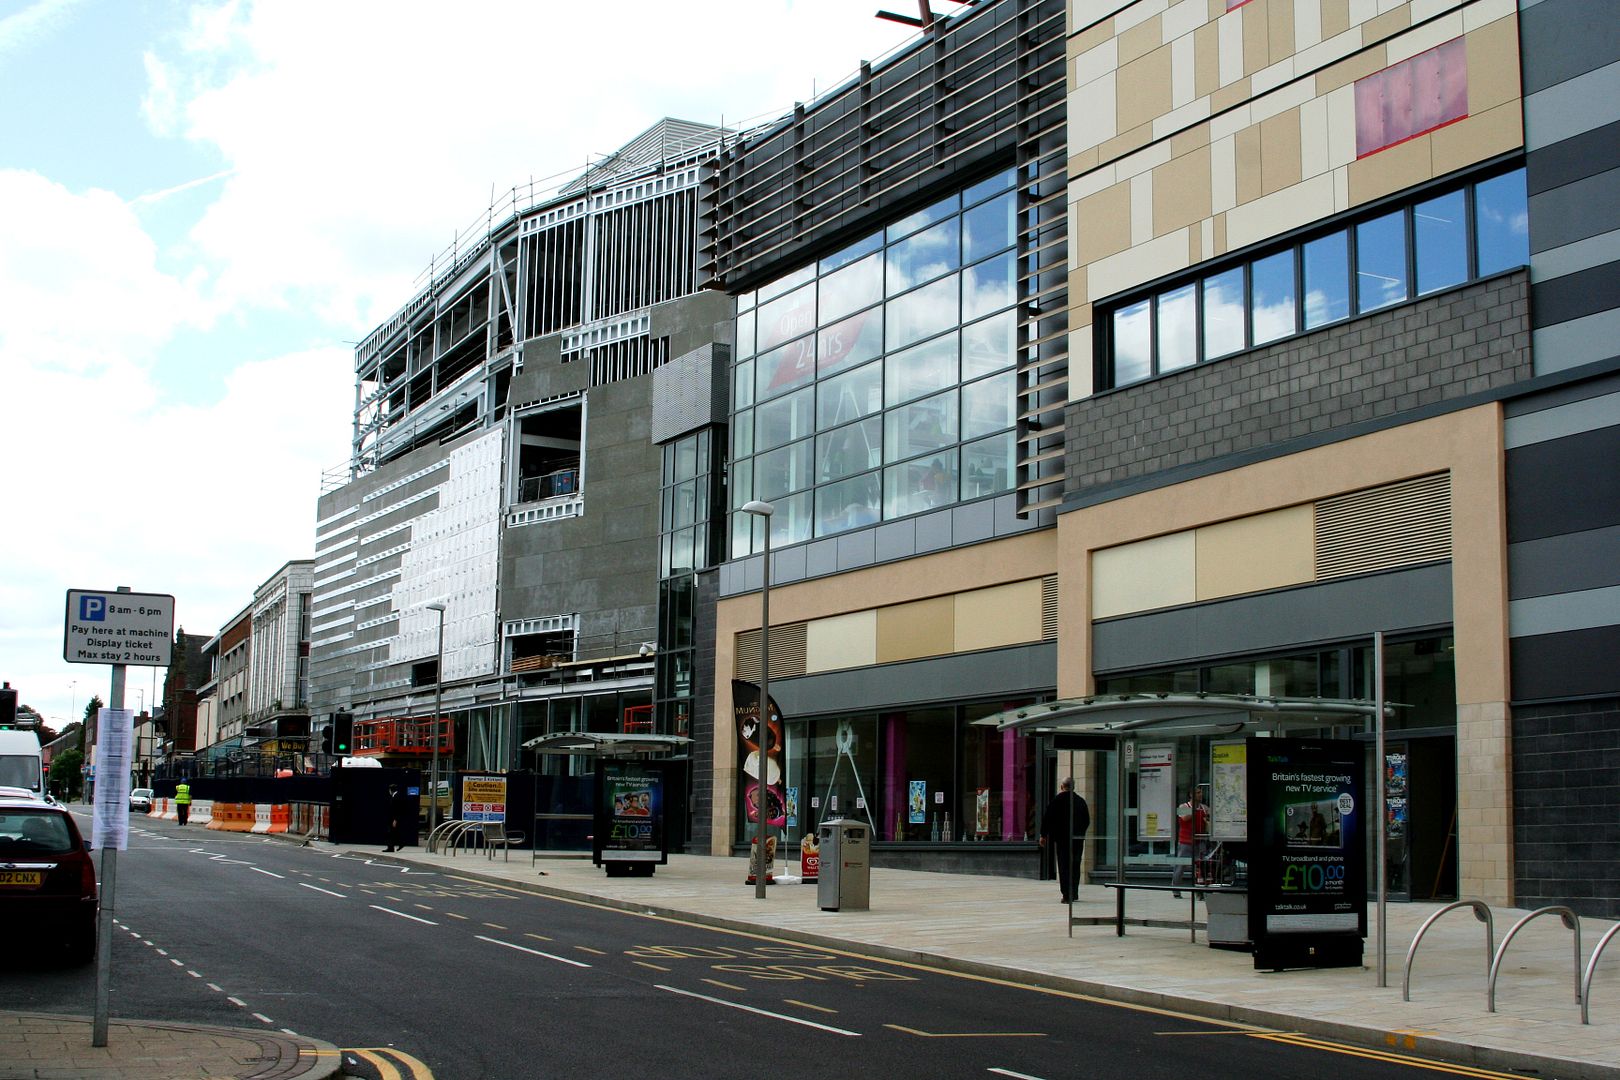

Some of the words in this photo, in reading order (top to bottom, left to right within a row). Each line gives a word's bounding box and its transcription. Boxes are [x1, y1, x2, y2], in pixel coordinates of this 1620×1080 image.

[781, 310, 812, 338] Open
[86, 598, 102, 619] P
[109, 605, 116, 613] 8
[117, 606, 132, 614] am
[138, 606, 146, 615] 6
[146, 608, 162, 617] pm
[71, 625, 89, 635] Pay
[92, 626, 114, 635] here
[116, 628, 127, 636] at
[129, 628, 169, 638] machine
[87, 638, 122, 649] Display
[125, 640, 153, 649] ticket
[78, 650, 98, 659] Max
[101, 651, 122, 661] stay
[124, 652, 131, 660] 2
[133, 652, 161, 661] hours
[1272, 772, 1300, 782] Britain's
[1300, 772, 1325, 782] fastest
[1325, 774, 1352, 784] growing
[1301, 784, 1312, 792] TV
[16, 873, 37, 883] CNX
